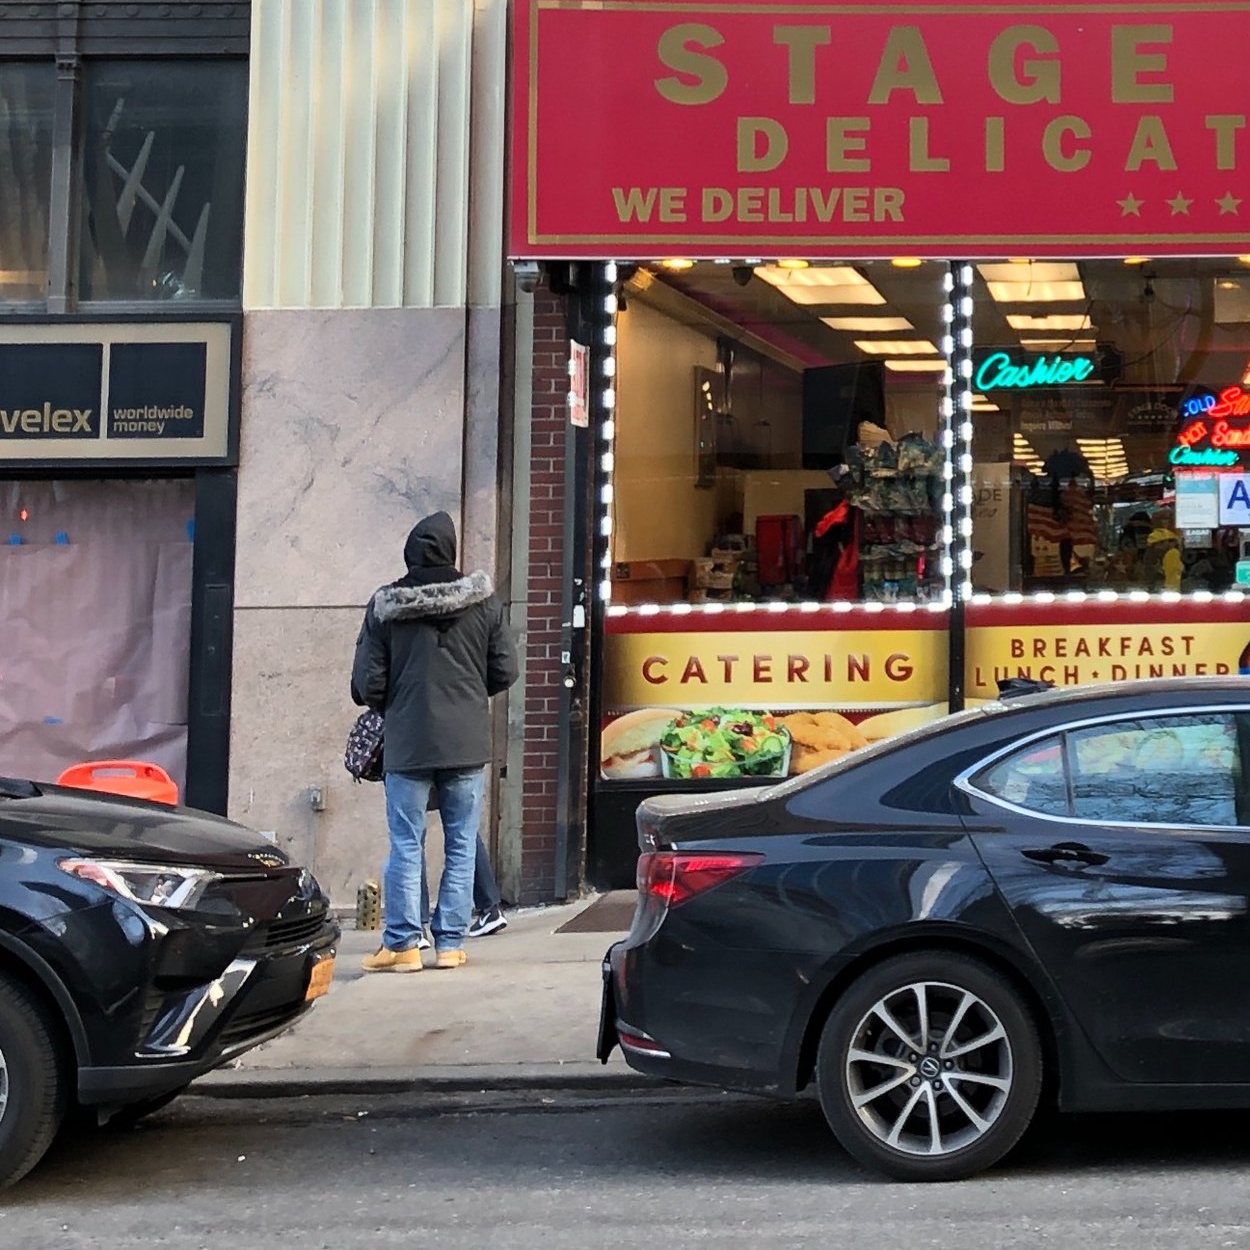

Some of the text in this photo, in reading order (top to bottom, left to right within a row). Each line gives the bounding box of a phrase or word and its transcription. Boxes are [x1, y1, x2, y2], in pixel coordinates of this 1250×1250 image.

[653, 22, 1176, 106] STAGE
[612, 187, 906, 223] WE DELIVER
[976, 351, 1096, 393] Cashier
[113, 405, 194, 420] worldwide
[113, 419, 165, 436] money
[1178, 421, 1208, 446] HOT
[1011, 636, 1196, 659] BREAKFAST
[641, 653, 915, 685] CATERING
[974, 664, 1080, 687] LUNCH
